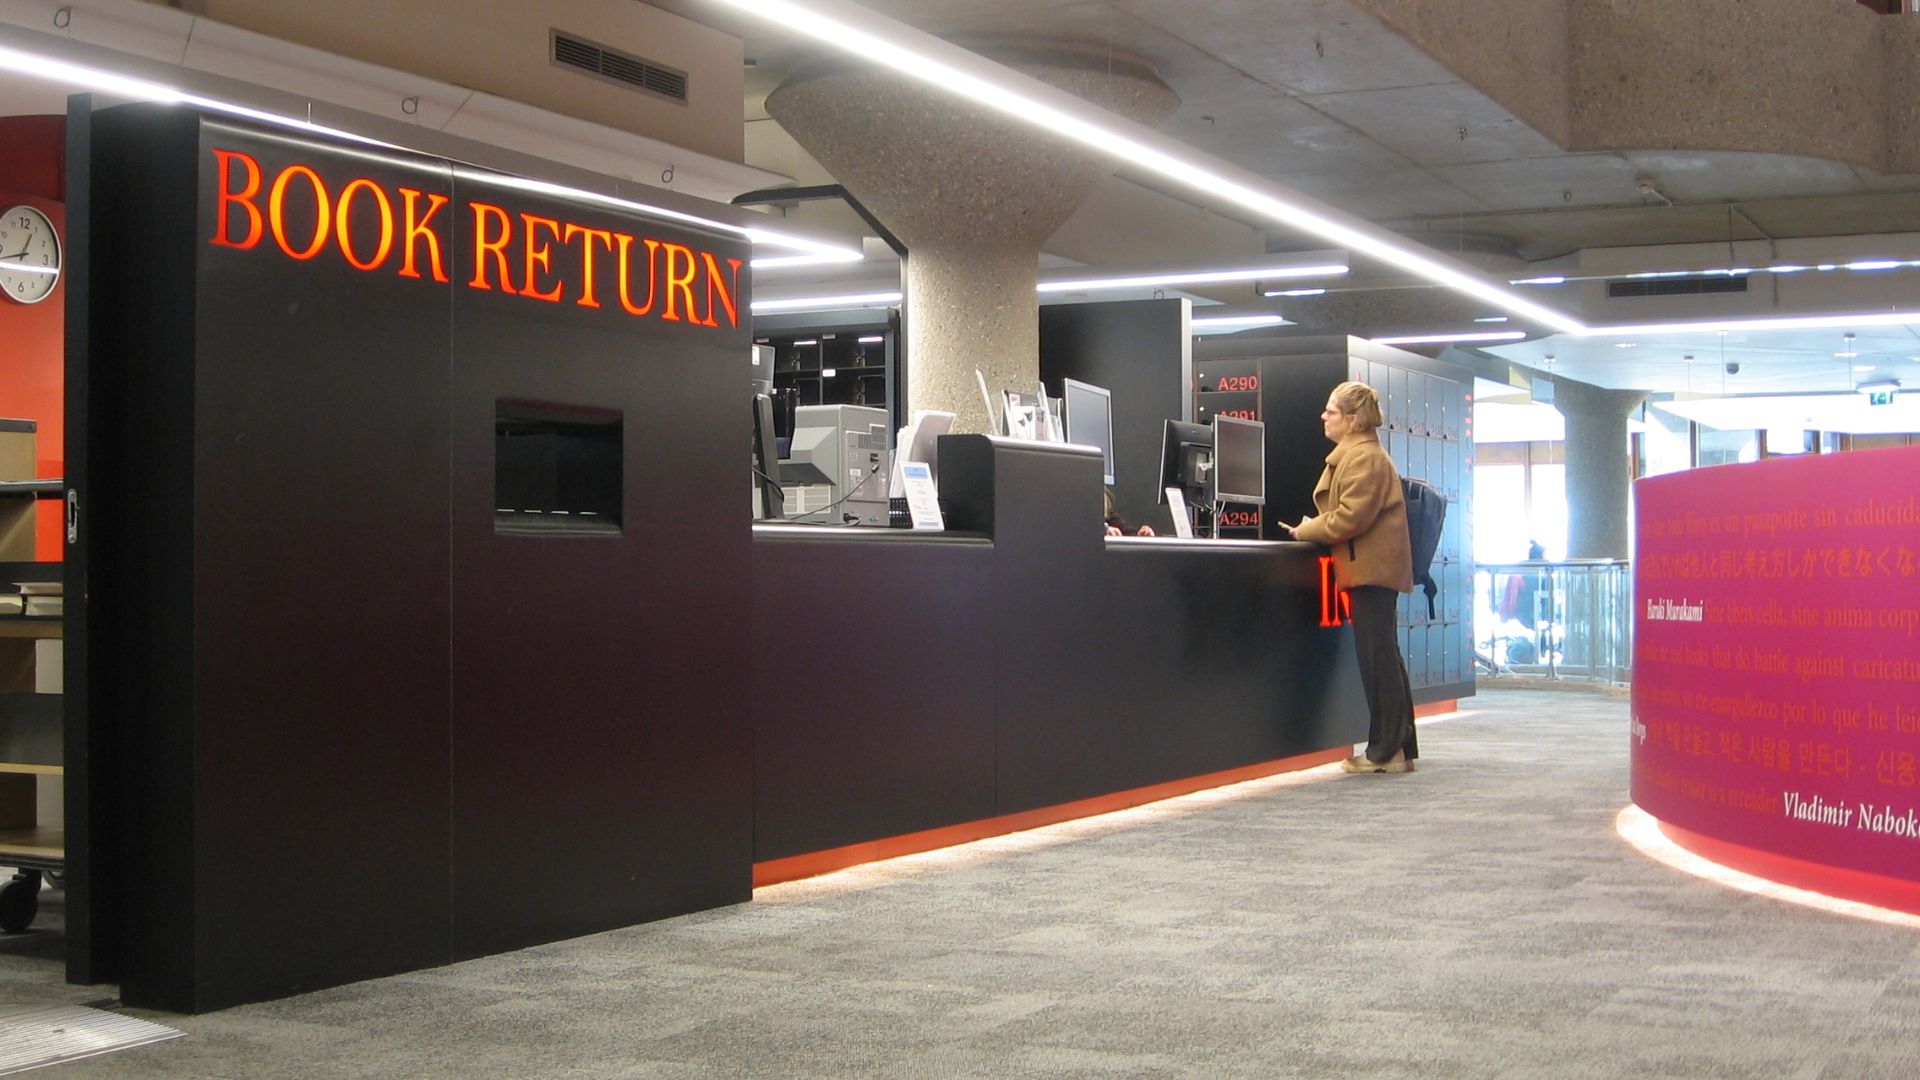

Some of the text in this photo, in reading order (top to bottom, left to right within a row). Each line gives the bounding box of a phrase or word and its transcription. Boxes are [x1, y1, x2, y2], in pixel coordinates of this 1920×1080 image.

[19, 217, 31, 230] 12
[209, 148, 742, 329] BOOK RETURN
[42, 254, 48, 266] 3
[18, 282, 24, 293] 6
[1218, 376, 1258, 391] A290
[1220, 512, 1259, 526] A294
[1744, 506, 1808, 538] pasaporte
[1814, 504, 1836, 529] sin
[1792, 604, 1820, 626] sine
[1824, 602, 1872, 628] anima
[1794, 650, 1844, 682] against
[1784, 701, 1806, 730] por
[1812, 697, 1827, 725] lo
[1832, 706, 1861, 734] que
[1868, 700, 1888, 730] he
[1749, 735, 1793, 771] 사람을
[1799, 739, 1853, 778] 만든다
[1876, 749, 1920, 788] 신용
[1784, 792, 1853, 828] Vladimir
[1858, 803, 1920, 839] Nabok
